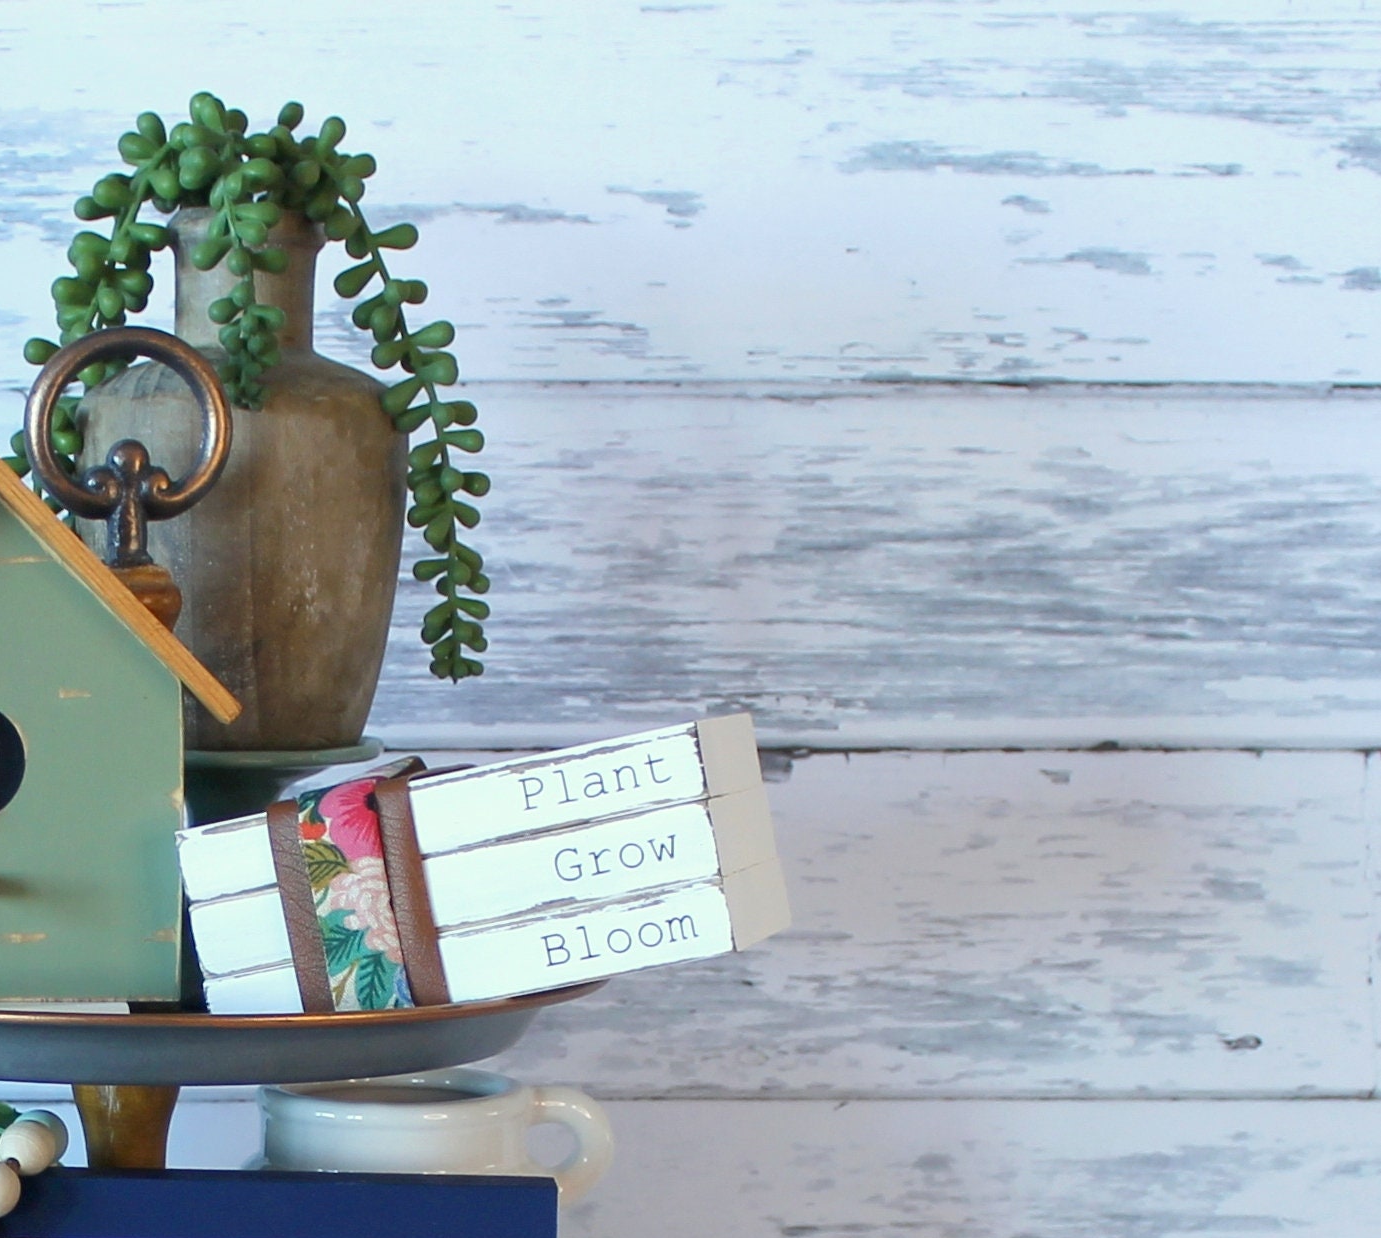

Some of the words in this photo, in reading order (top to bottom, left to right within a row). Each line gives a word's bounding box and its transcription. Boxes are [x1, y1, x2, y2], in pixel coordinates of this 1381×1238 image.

[518, 751, 673, 811] Plant
[554, 833, 677, 883] Grow
[541, 911, 700, 967] Bloom
